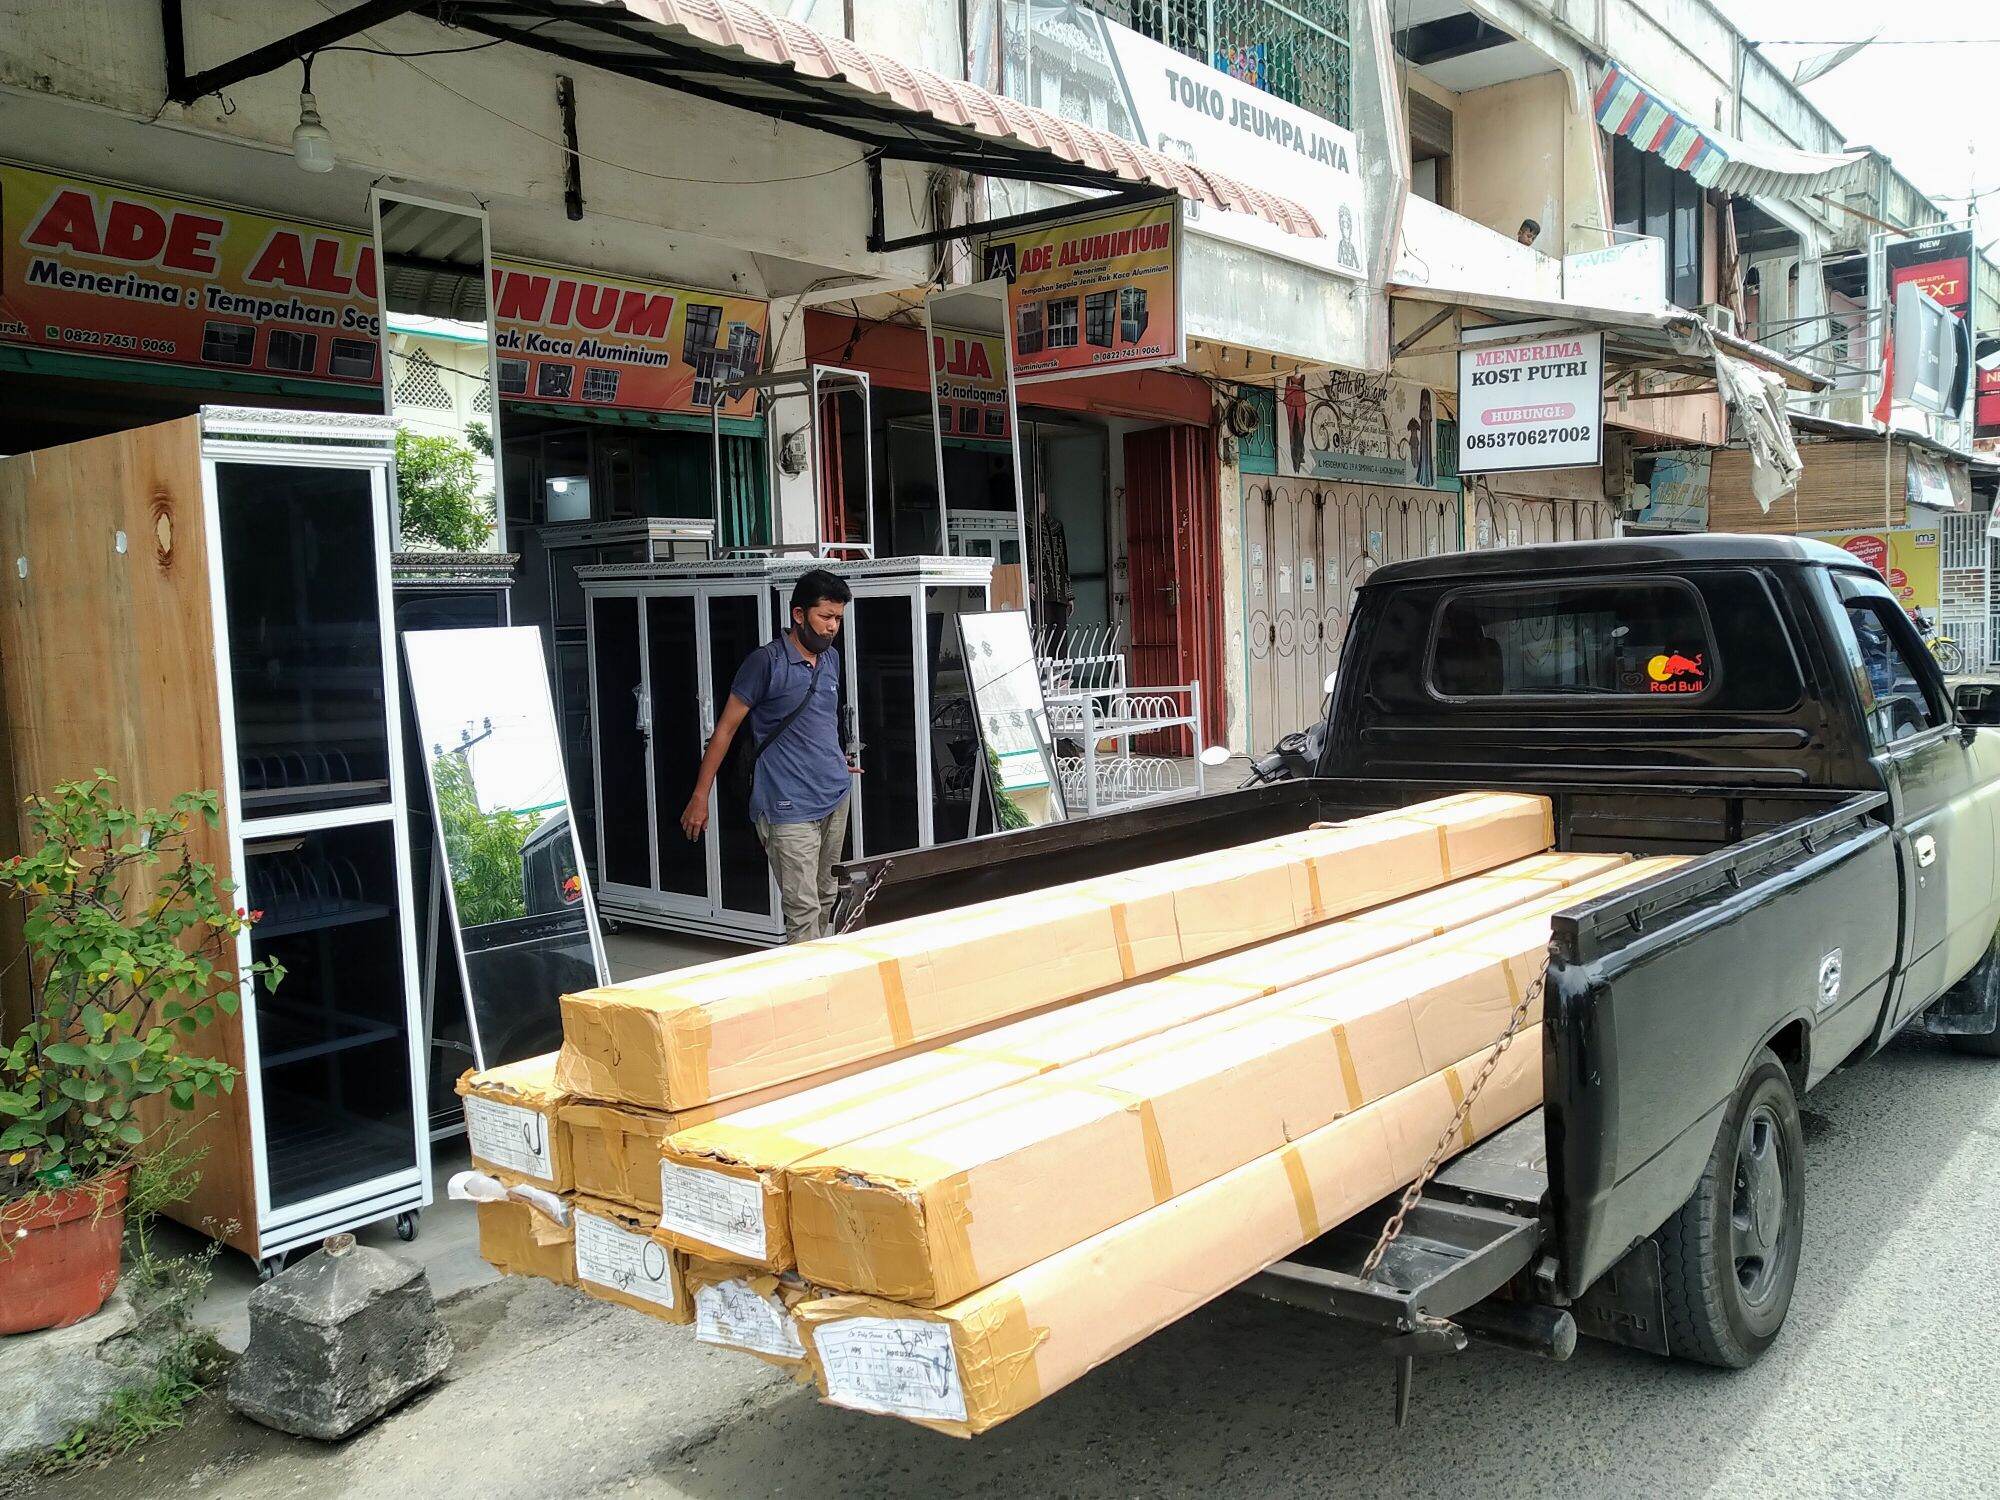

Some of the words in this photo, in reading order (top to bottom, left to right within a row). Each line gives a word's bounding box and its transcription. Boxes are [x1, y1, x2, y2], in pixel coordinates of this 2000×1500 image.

[1165, 69, 1224, 121] TOKO
[1229, 97, 1306, 155] JEUMPA
[1307, 131, 1350, 174] JAYA
[26, 190, 225, 274] ADE
[1919, 240, 1941, 249] NEW
[1020, 244, 1054, 275] ADE
[1058, 222, 1170, 267] ALUMINIUM
[1021, 284, 1054, 296] Tempahan
[1055, 280, 1078, 291] Segala
[1079, 277, 1096, 286] Jenis
[1098, 275, 1111, 283] Rak
[1113, 272, 1130, 280] Kaca
[1132, 265, 1169, 277] Aluminium
[1073, 265, 1107, 277] Menerima
[1919, 280, 1960, 298] EXT
[29, 259, 180, 304] Menerima
[204, 288, 336, 327] Tempahan
[342, 308, 381, 336] Seg
[495, 329, 521, 350] ak
[526, 330, 572, 356] Kaca
[577, 339, 669, 367] Aluminium
[0, 321, 27, 335] rsk
[64, 329, 100, 344] 0822
[104, 334, 137, 348] 7451
[142, 339, 175, 353] 9066
[1102, 350, 1120, 360] 0822
[1122, 348, 1140, 358] 7451
[1142, 345, 1160, 355] 9066
[1475, 341, 1584, 367] MENERIMA
[1471, 367, 1522, 387] KOST
[1527, 360, 1588, 381] PUTRI
[1490, 406, 1565, 423] HUBUNGI:
[1466, 425, 1591, 450] 085370627002
[1914, 533, 1936, 542] im3
[1650, 681, 1676, 692] Red
[1679, 681, 1703, 692] Bull
